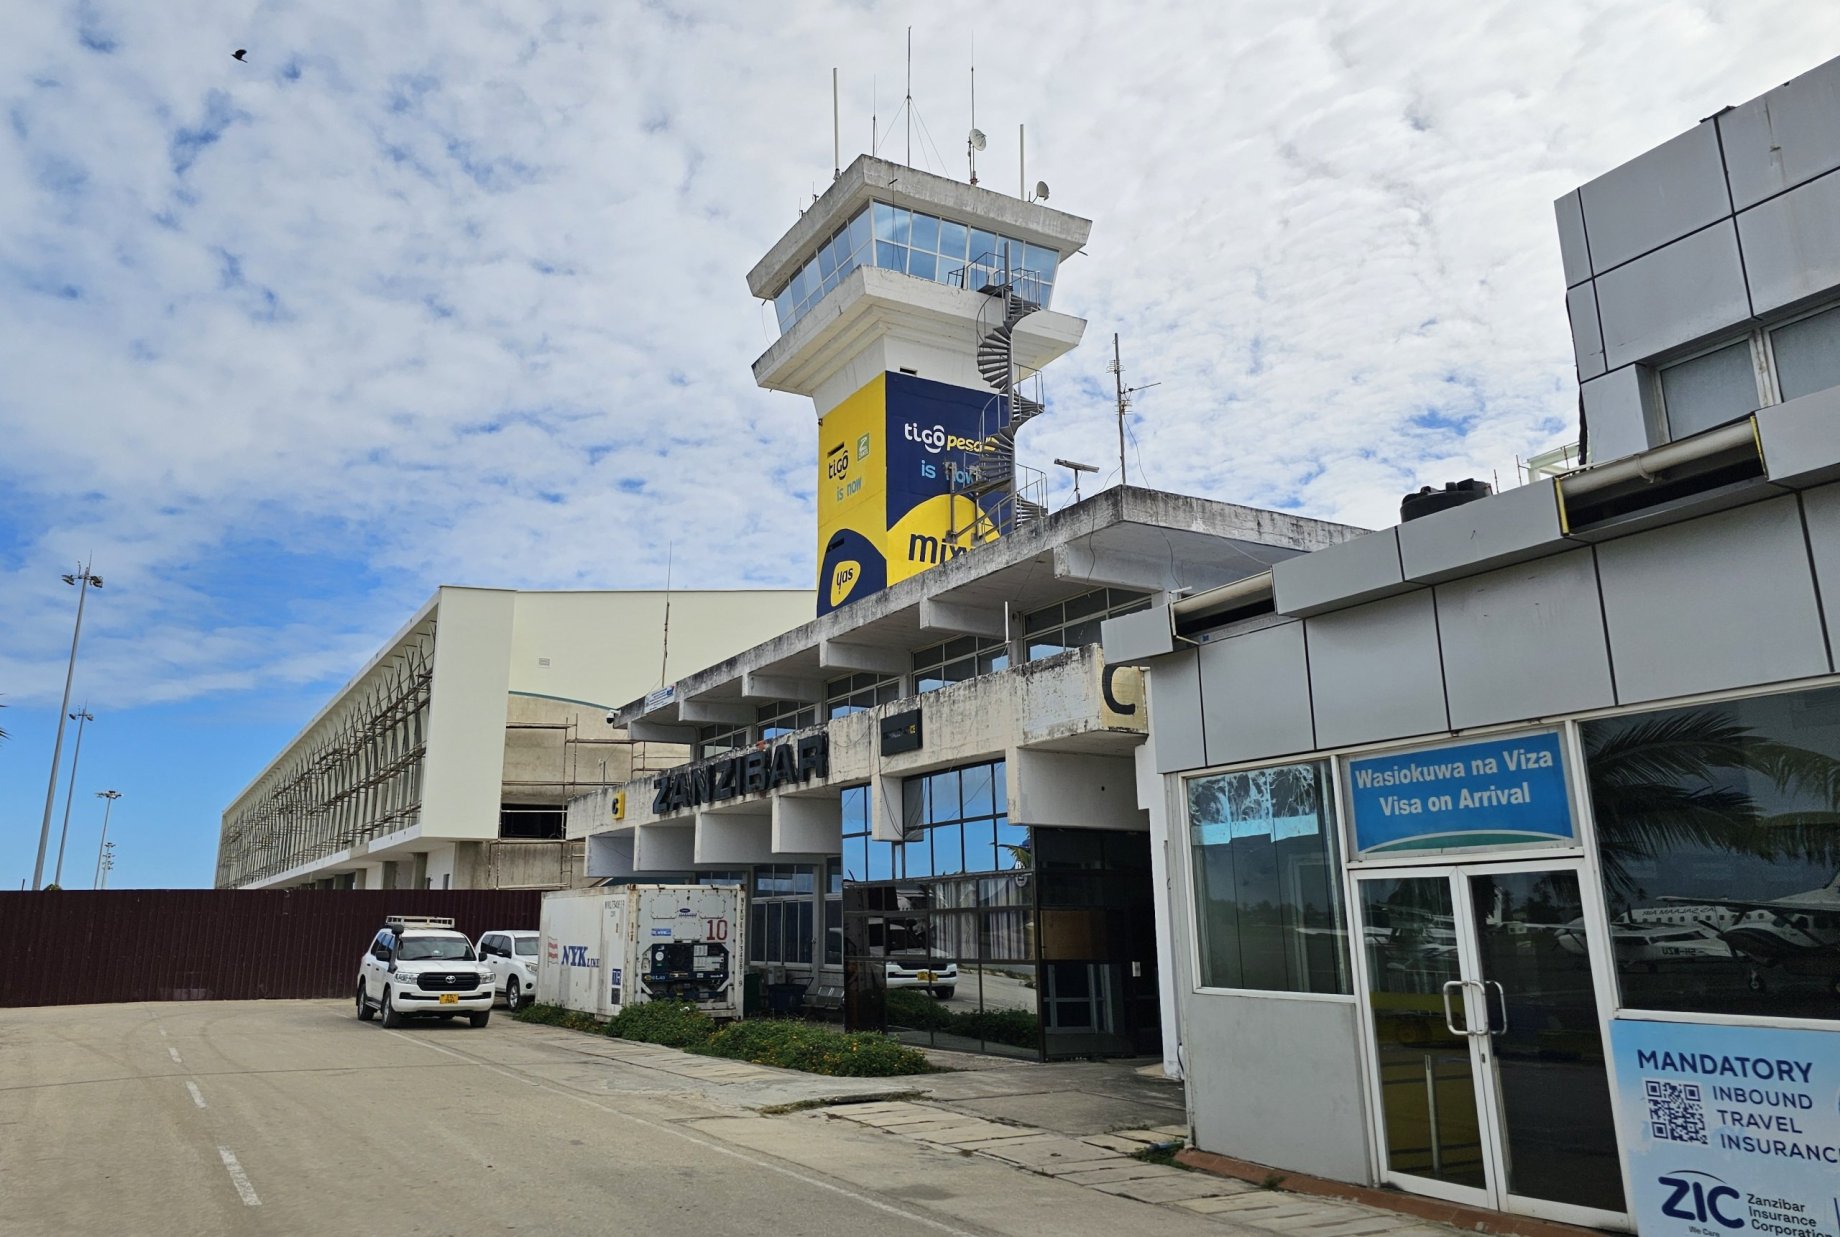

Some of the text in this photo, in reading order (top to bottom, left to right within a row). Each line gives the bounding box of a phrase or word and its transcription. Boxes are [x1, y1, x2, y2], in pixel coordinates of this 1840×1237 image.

[904, 422, 945, 454] tigo
[828, 449, 849, 480] tigo
[921, 459, 936, 479] is
[836, 477, 862, 502] is now
[836, 567, 854, 595] yas
[652, 734, 829, 815] ZANZIBAR
[1354, 749, 1553, 789] Wasiokuwa na Viza
[1379, 781, 1531, 816] Visa on Arrival
[706, 919, 728, 941] 10
[561, 945, 588, 967] NYK
[1637, 1049, 1813, 1083] MANDATORY
[1712, 1085, 1813, 1110] INBOUND
[1716, 1109, 1803, 1134] TRAVEL
[1720, 1134, 1840, 1164] INSURANC
[1658, 1174, 1745, 1229] ZIC
[1746, 1193, 1806, 1213] Zanzibar
[1748, 1206, 1817, 1228] Insurance
